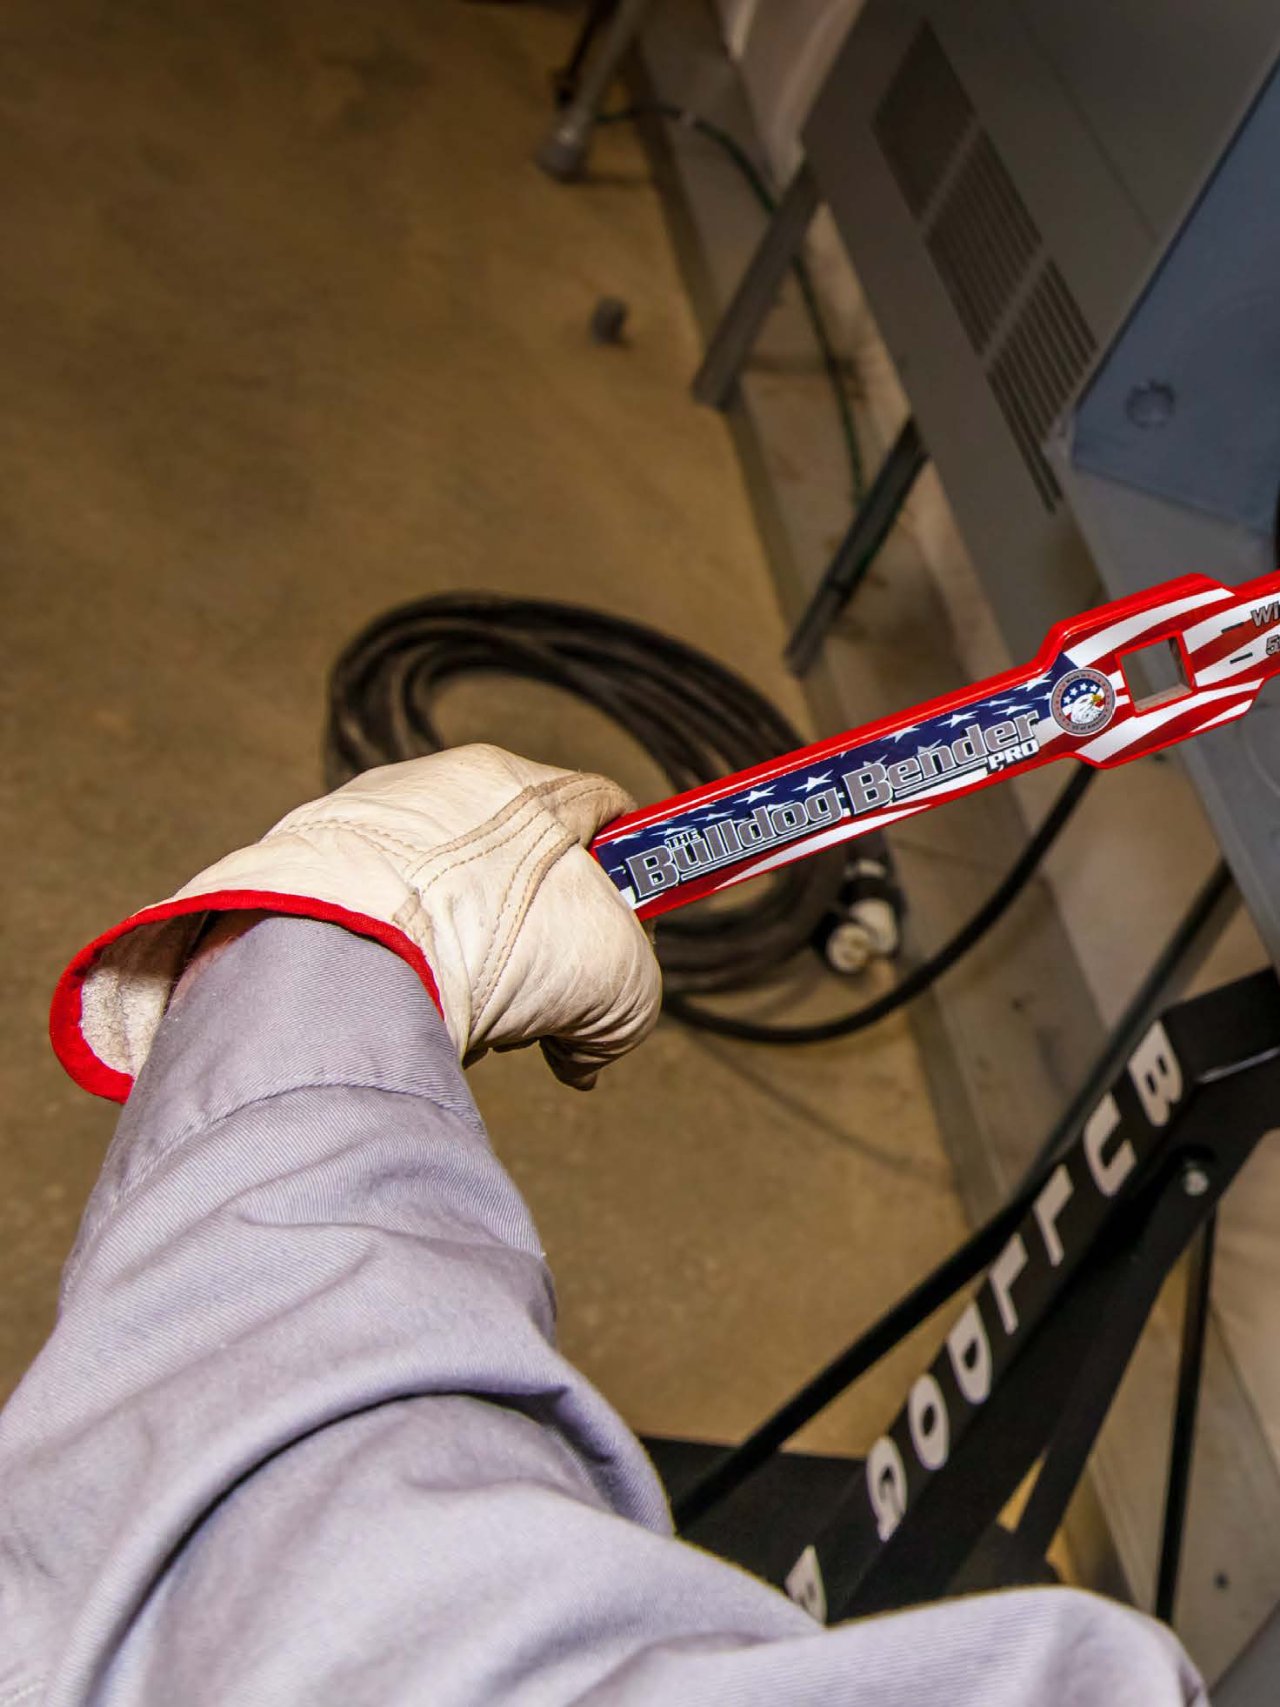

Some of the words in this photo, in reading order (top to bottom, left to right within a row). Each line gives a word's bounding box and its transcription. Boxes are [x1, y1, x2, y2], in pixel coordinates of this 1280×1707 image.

[625, 786, 843, 899] Bulldog
[841, 708, 1040, 815] Bender
[987, 738, 1040, 771] PRO
[664, 828, 701, 850] THE
[866, 1019, 1183, 1543] BULLDOG
